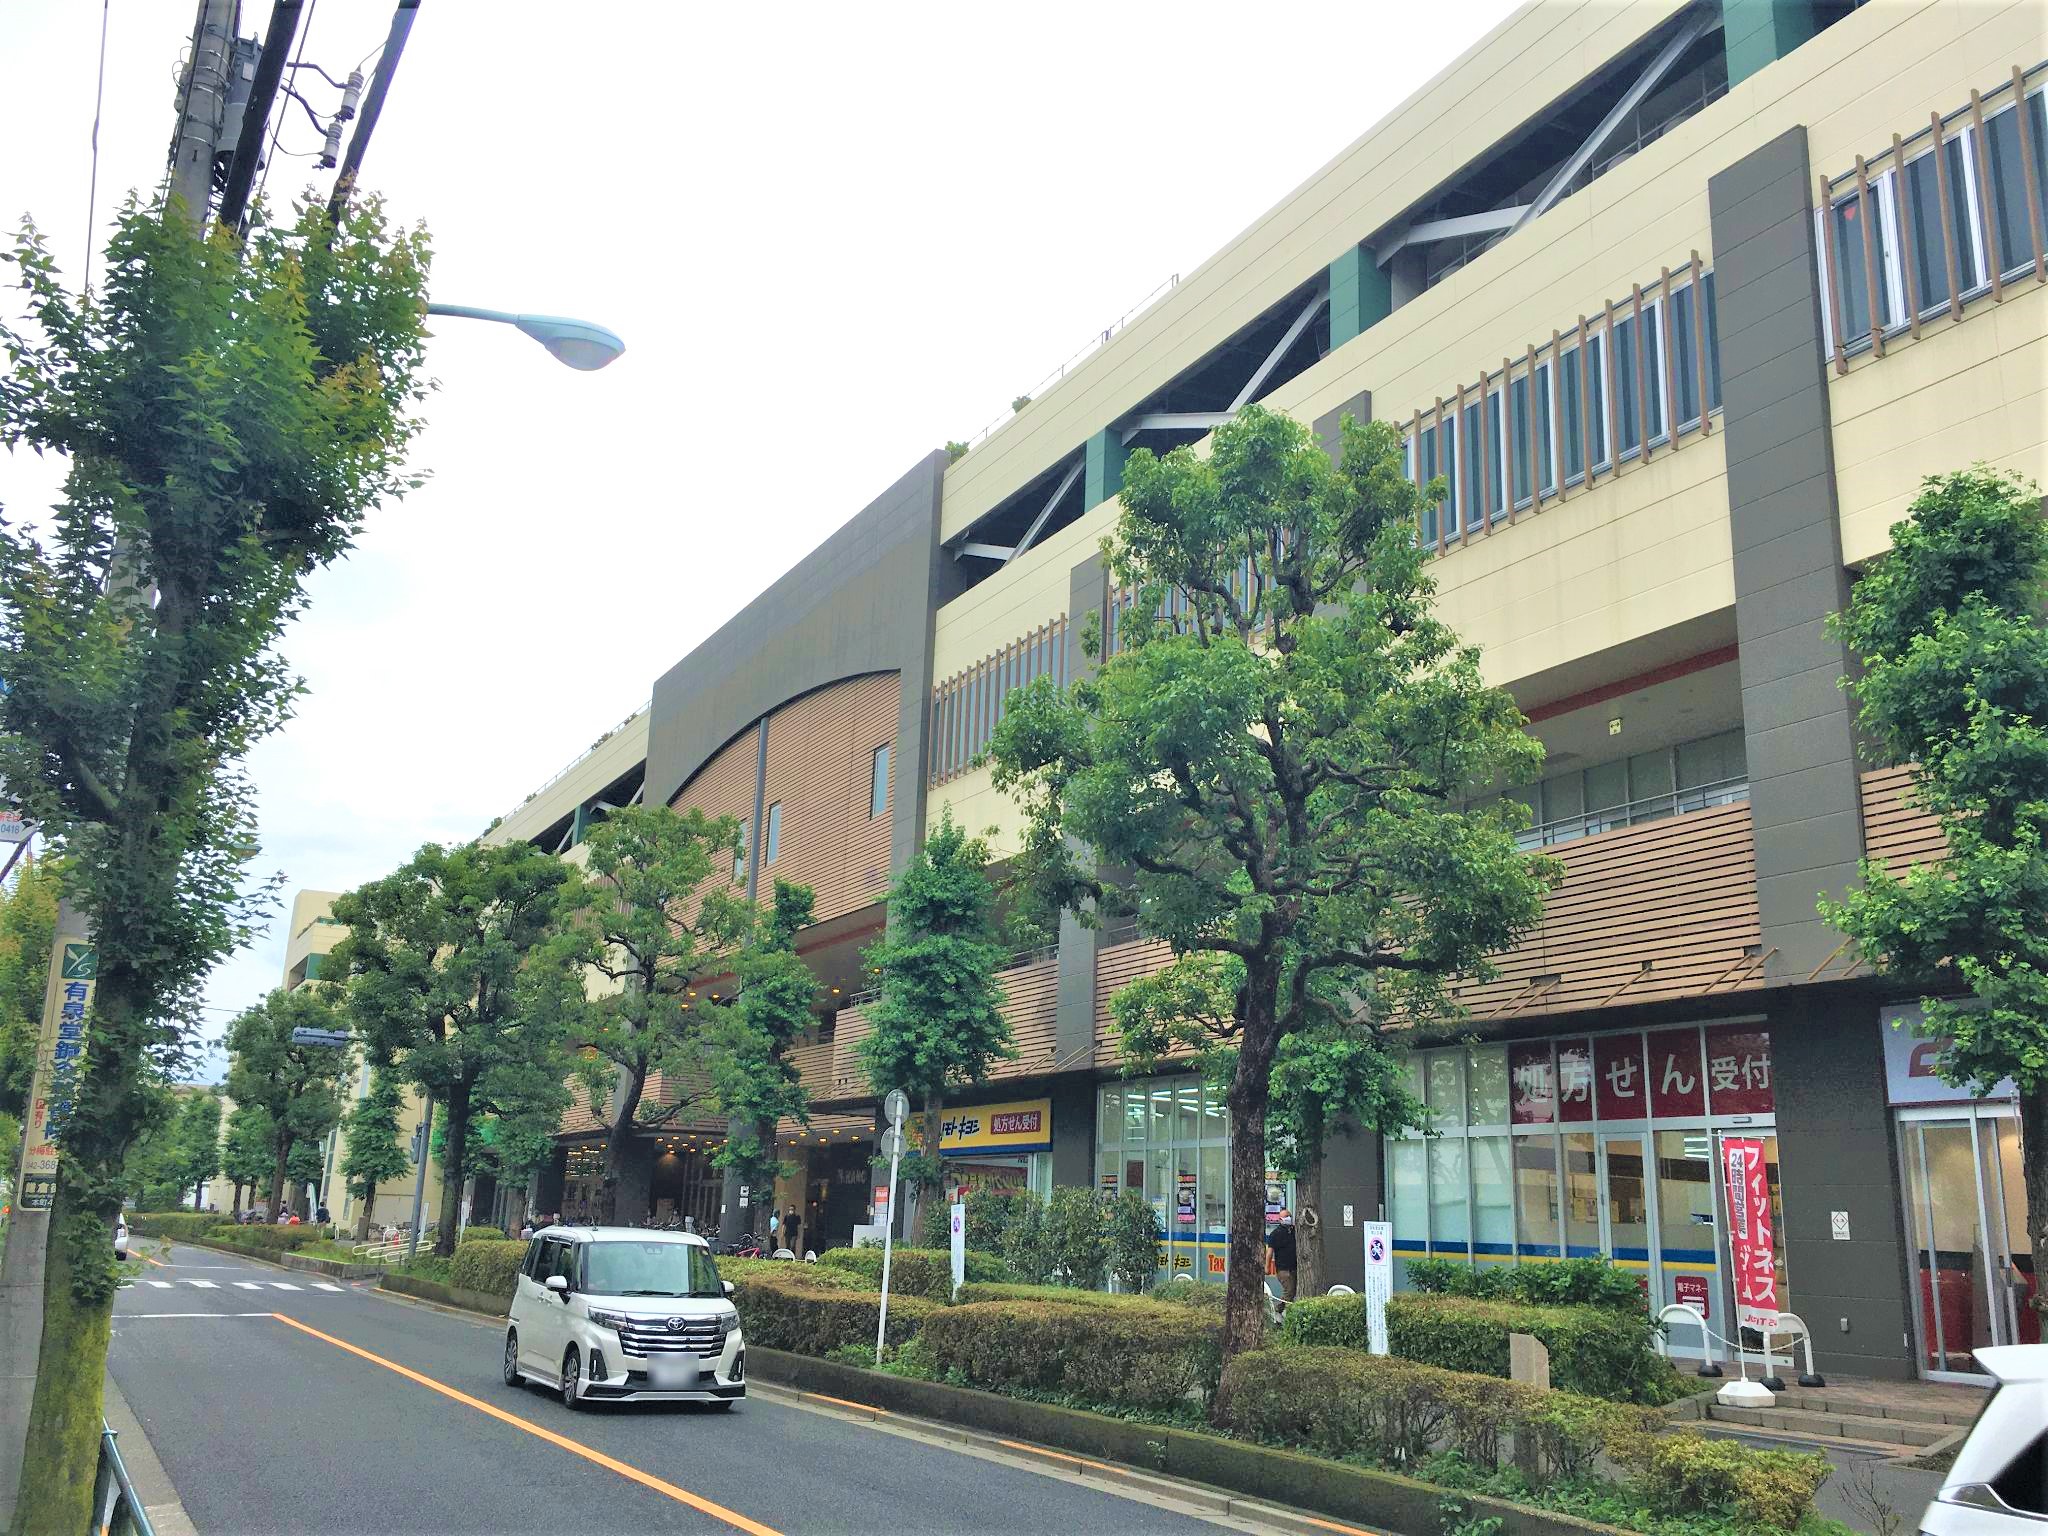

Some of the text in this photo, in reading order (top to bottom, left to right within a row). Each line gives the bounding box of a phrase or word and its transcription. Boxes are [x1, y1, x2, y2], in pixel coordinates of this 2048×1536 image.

[1513, 1053, 1772, 1105] 処方せん受付
[993, 1114, 1038, 1133] 処方せん受付
[1743, 1146, 1777, 1304] フィットネス
